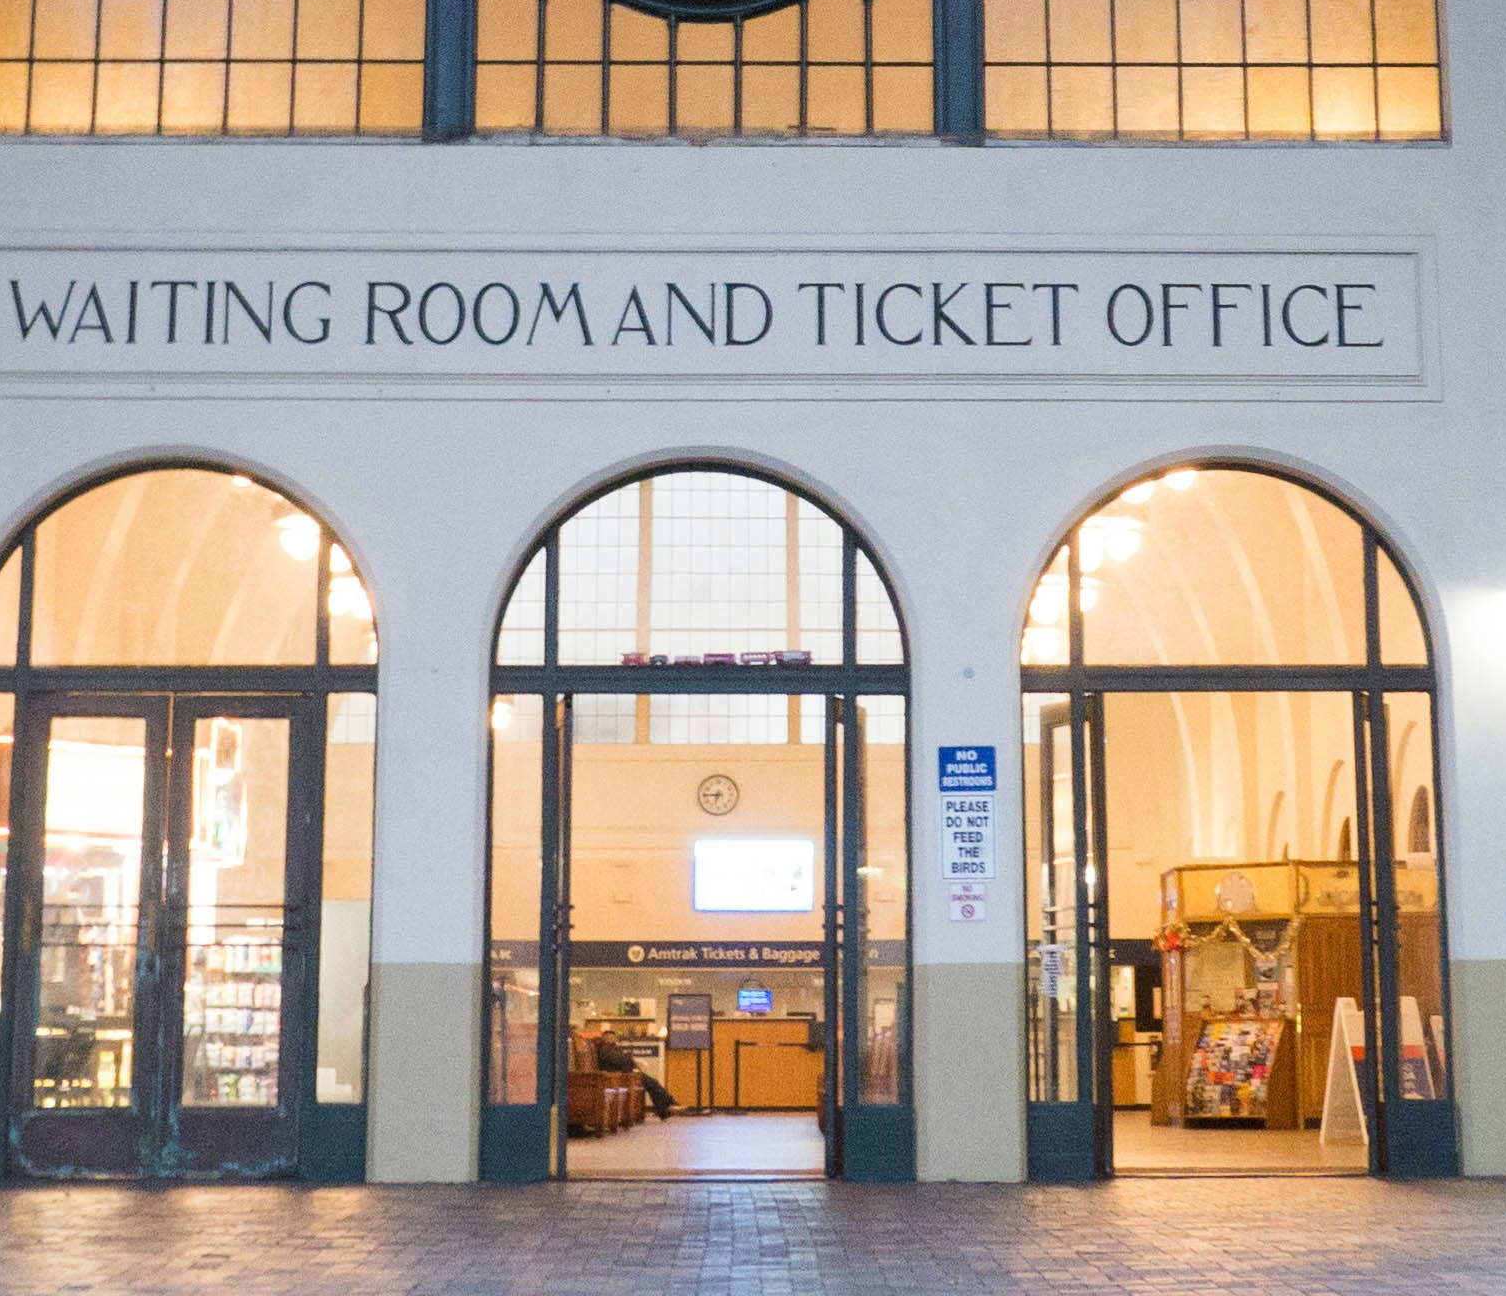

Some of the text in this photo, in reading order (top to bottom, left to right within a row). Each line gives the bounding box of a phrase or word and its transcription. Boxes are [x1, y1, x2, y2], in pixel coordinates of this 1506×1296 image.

[8, 280, 1384, 347] WAITING ROOM AND TICKET OFFICE
[956, 750, 978, 761] NO
[946, 763, 988, 774] PUBLIC
[943, 776, 993, 787] RESTROOMS
[946, 801, 989, 812] PLEASE
[946, 816, 989, 828] DO NOT
[953, 831, 983, 843] FEED
[958, 846, 980, 858] THE
[951, 862, 986, 874] BIRDS
[648, 947, 820, 963] Amtrak Tickets & Baggage
